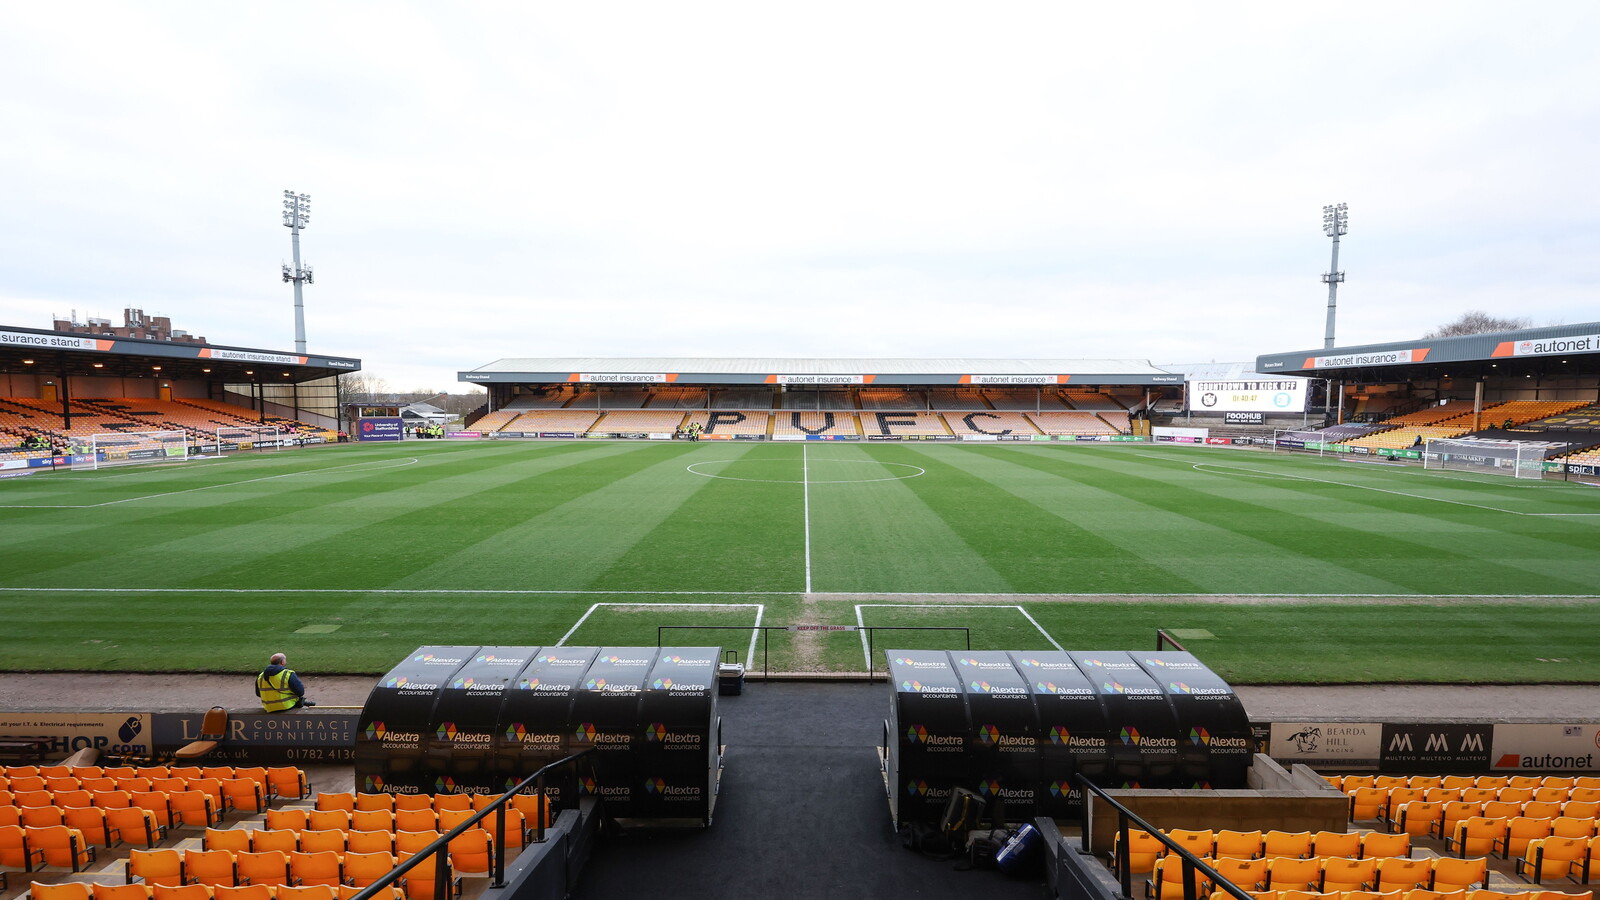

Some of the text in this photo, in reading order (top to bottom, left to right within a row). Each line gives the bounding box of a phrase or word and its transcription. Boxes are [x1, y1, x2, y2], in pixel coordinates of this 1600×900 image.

[0, 334, 80, 347] surance stand
[1534, 338, 1590, 353] autonet
[222, 351, 291, 362] autonet insurance stand
[1324, 353, 1397, 366] autonet insurance
[254, 720, 349, 730] CONTRACT
[254, 732, 350, 741] FURNITURE
[383, 731, 420, 742] Alextra
[454, 732, 491, 742] Alextra
[524, 733, 560, 743] Alextra
[594, 733, 630, 743] Alextra
[664, 733, 700, 743] Alextra
[927, 735, 963, 745] Alextra
[999, 735, 1035, 745] Alextra
[1069, 736, 1105, 747] Alextra
[1140, 737, 1176, 747] Alextra
[1210, 737, 1247, 747] Alextra
[287, 749, 324, 760] 01782
[1522, 754, 1592, 768] autonet
[382, 784, 419, 793] Alextra
[454, 785, 490, 794] Alextra
[524, 786, 560, 795] Aletra
[664, 786, 700, 795] Alextra
[998, 788, 1034, 798] Alextra
